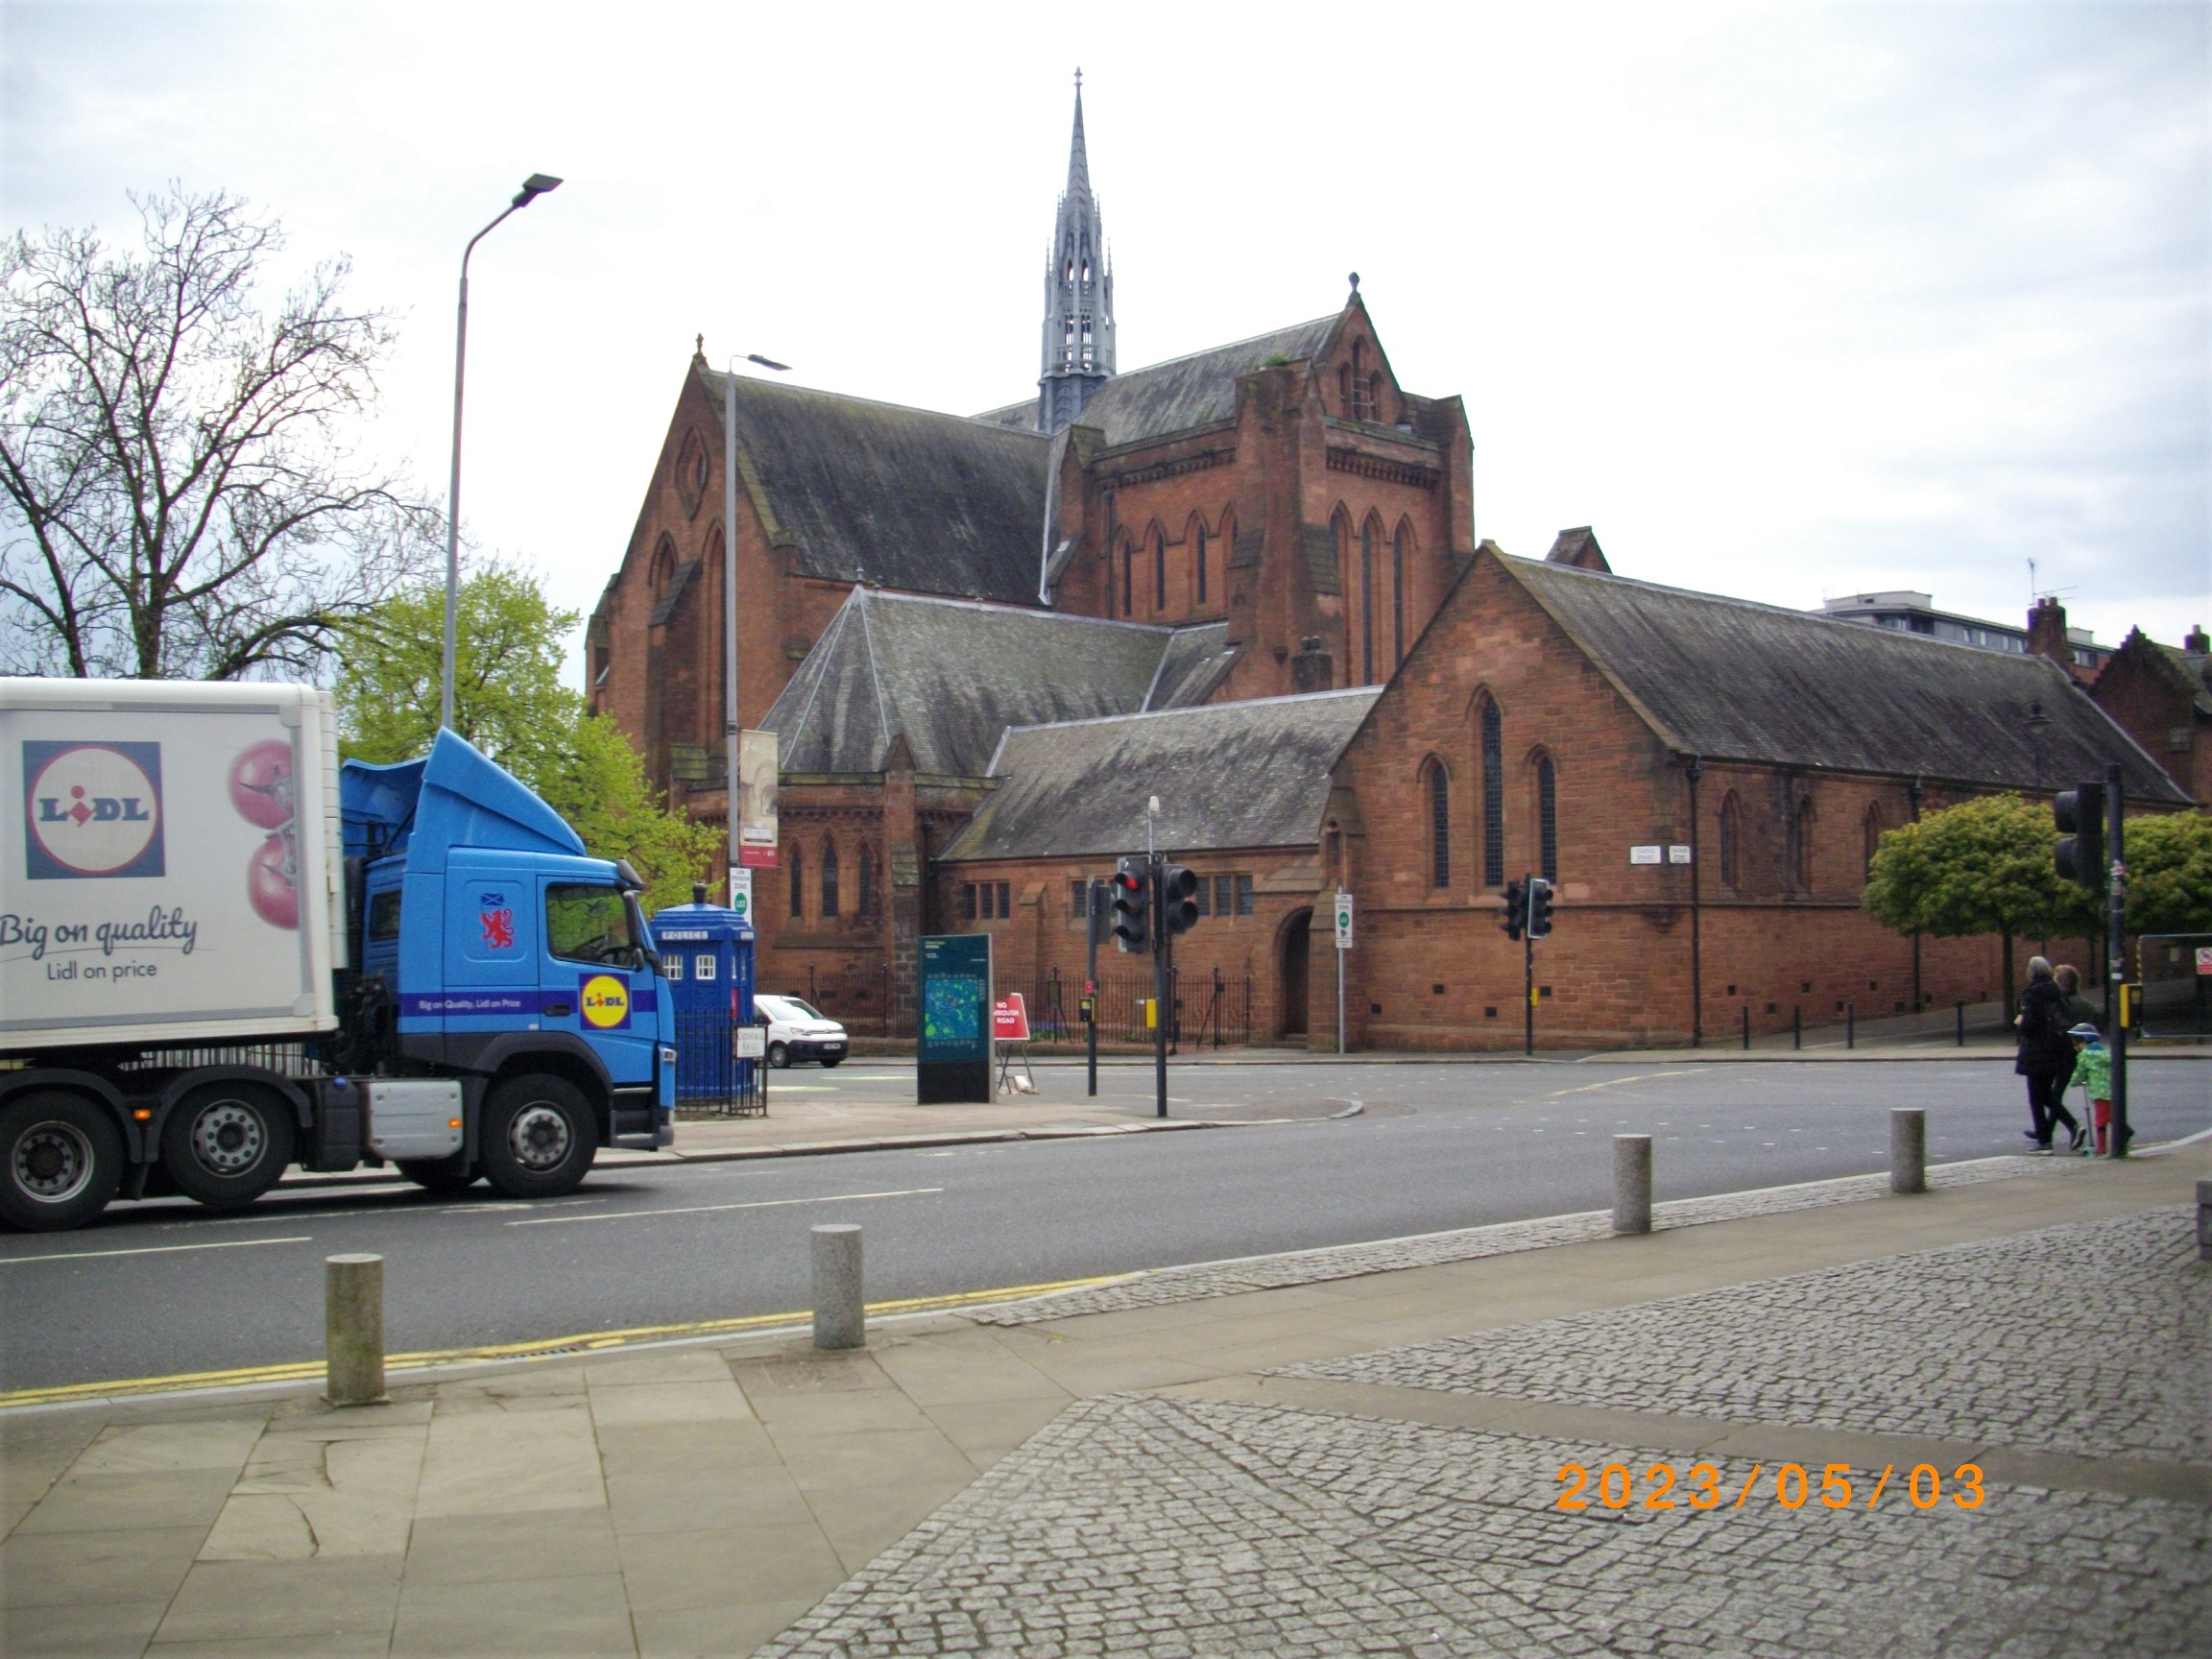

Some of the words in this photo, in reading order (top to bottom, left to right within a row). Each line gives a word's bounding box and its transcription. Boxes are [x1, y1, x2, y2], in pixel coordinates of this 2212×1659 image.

[0, 914, 47, 960] Big
[55, 925, 87, 943] on
[96, 905, 197, 956] quality
[664, 930, 706, 940] POLICE
[48, 961, 78, 980] Lidl
[84, 966, 107, 980] on
[112, 960, 157, 983] price
